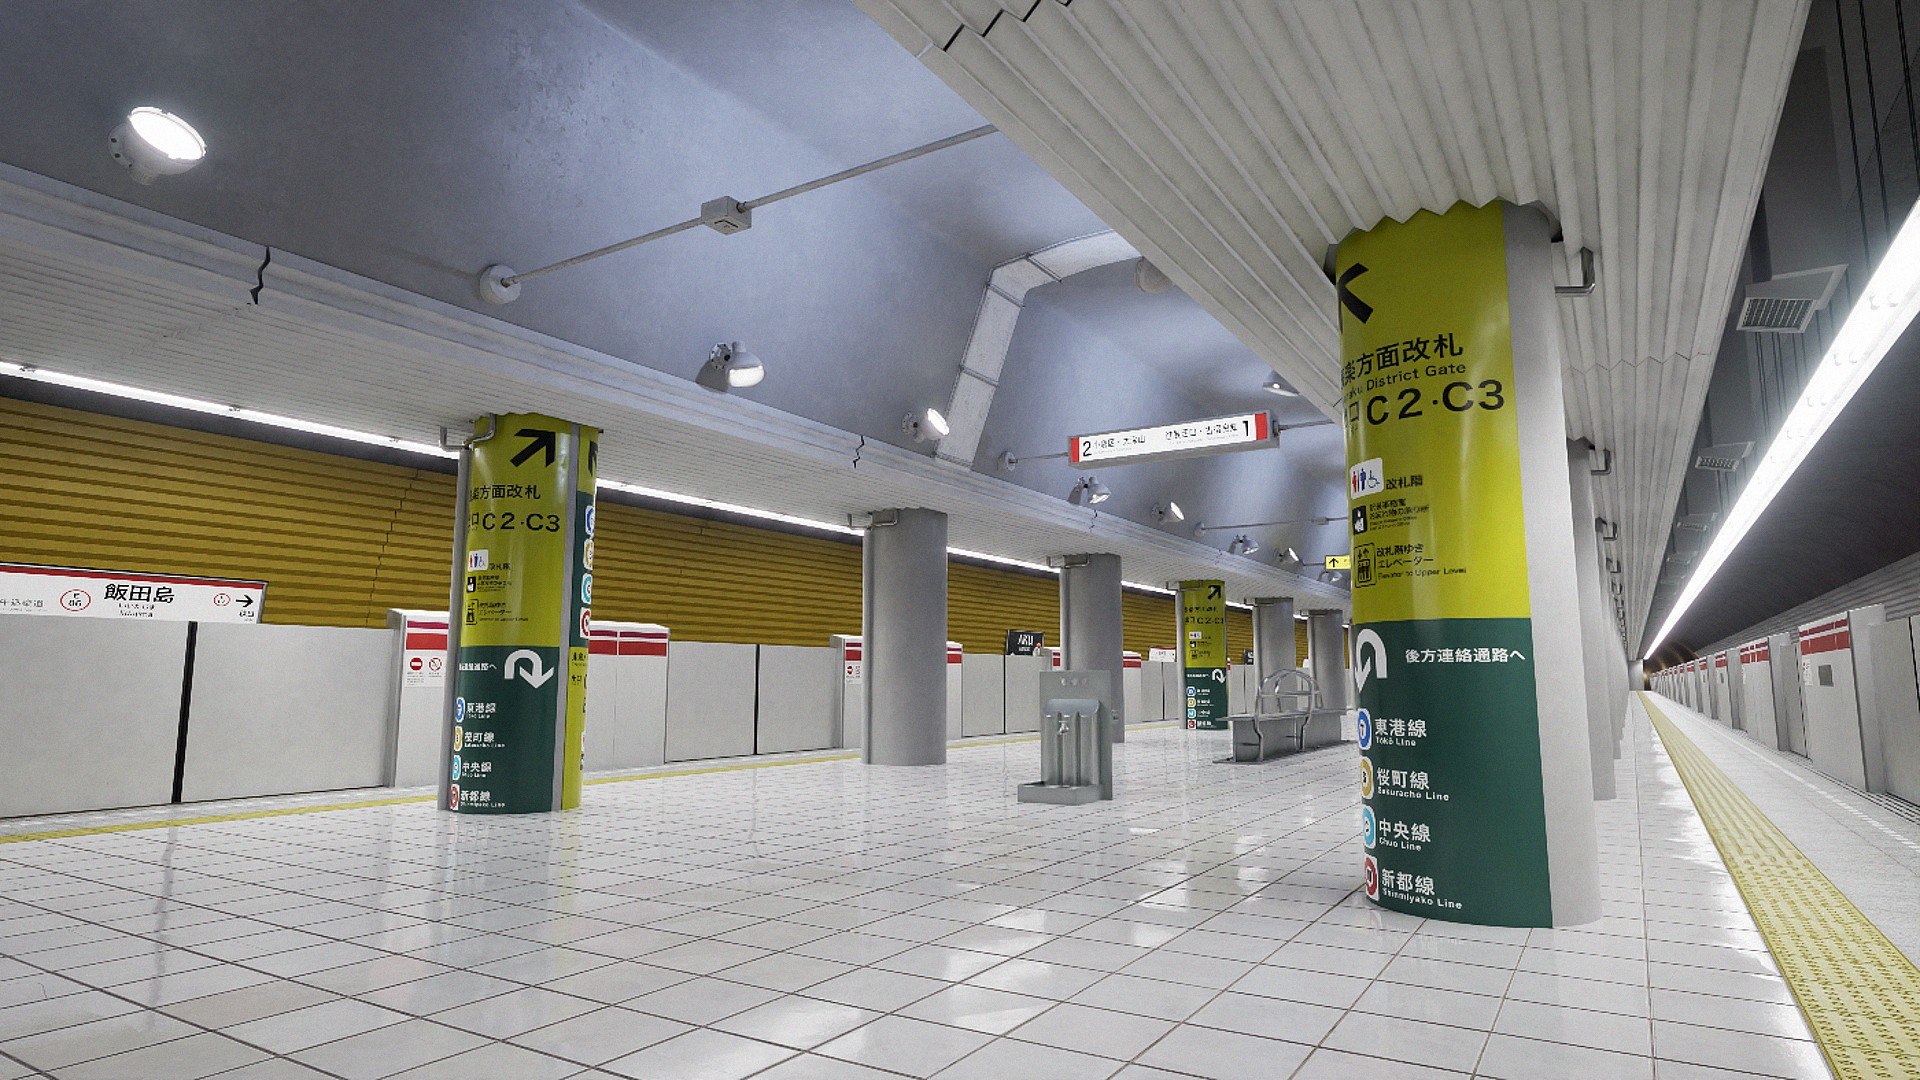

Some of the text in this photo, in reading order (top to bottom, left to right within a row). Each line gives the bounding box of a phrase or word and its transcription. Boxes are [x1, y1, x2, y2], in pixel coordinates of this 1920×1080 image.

[1341, 333, 1464, 389] 楽方面改札
[1366, 369, 1419, 391] District
[1425, 363, 1466, 377] Gate
[1242, 420, 1249, 437] 1
[1083, 441, 1092, 457] 2
[104, 583, 175, 603] 飯田島
[1406, 648, 1526, 664] 後方連絡通路へ
[1374, 718, 1427, 738] 東港線
[1395, 738, 1416, 747] Line
[1376, 767, 1430, 791] 桜町線
[1425, 792, 1449, 802] Line
[1379, 817, 1432, 843] 中央線
[1401, 842, 1422, 852] Line
[1381, 868, 1436, 896] 新都線
[1437, 898, 1463, 910] Line
